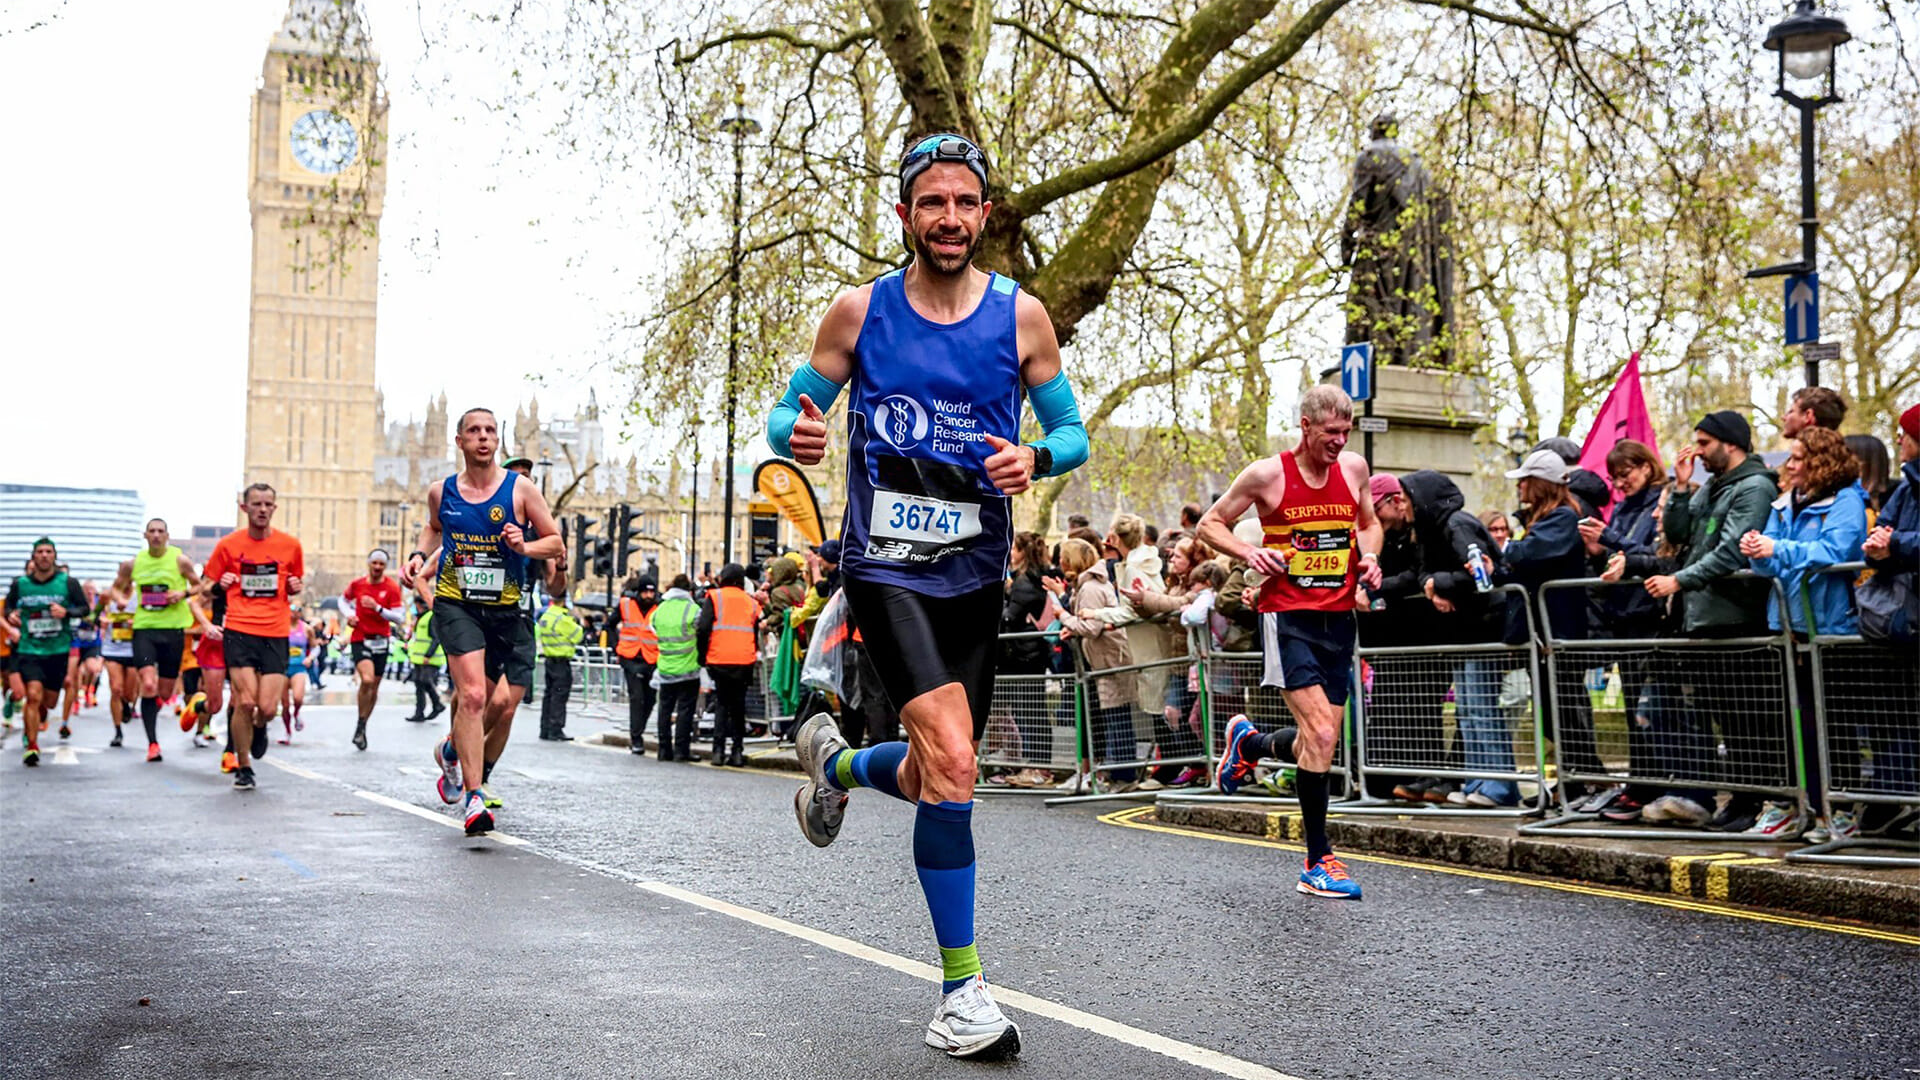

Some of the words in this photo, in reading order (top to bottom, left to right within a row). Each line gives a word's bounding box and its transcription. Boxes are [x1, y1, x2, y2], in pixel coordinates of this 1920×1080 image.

[933, 399, 971, 414] World
[934, 413, 977, 429] Cancer
[933, 439, 965, 454] Fund
[889, 502, 962, 534] 36747
[1284, 504, 1353, 520] SERPENTINE
[467, 533, 501, 543] VALLEY
[1304, 556, 1339, 571] 2419
